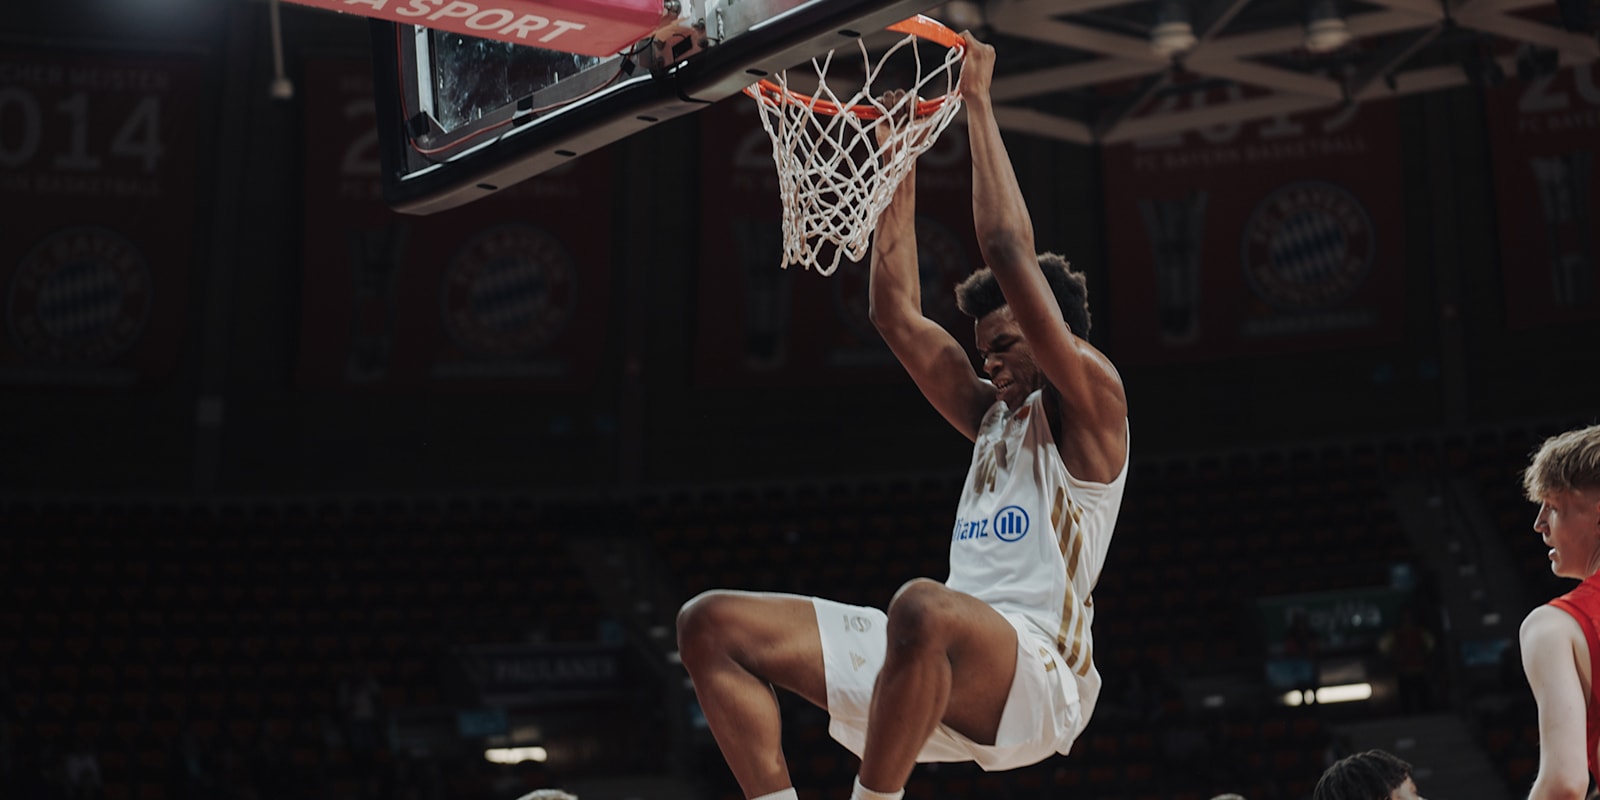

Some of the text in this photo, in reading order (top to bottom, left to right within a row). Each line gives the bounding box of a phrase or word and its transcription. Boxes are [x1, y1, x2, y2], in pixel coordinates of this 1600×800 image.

[395, 0, 587, 43] SPORT
[69, 69, 169, 92] MEISTER
[0, 87, 167, 172] 014
[1546, 109, 1600, 133] BAYE
[1163, 147, 1241, 168] BAYERN
[1244, 135, 1366, 163] BASKETBALL
